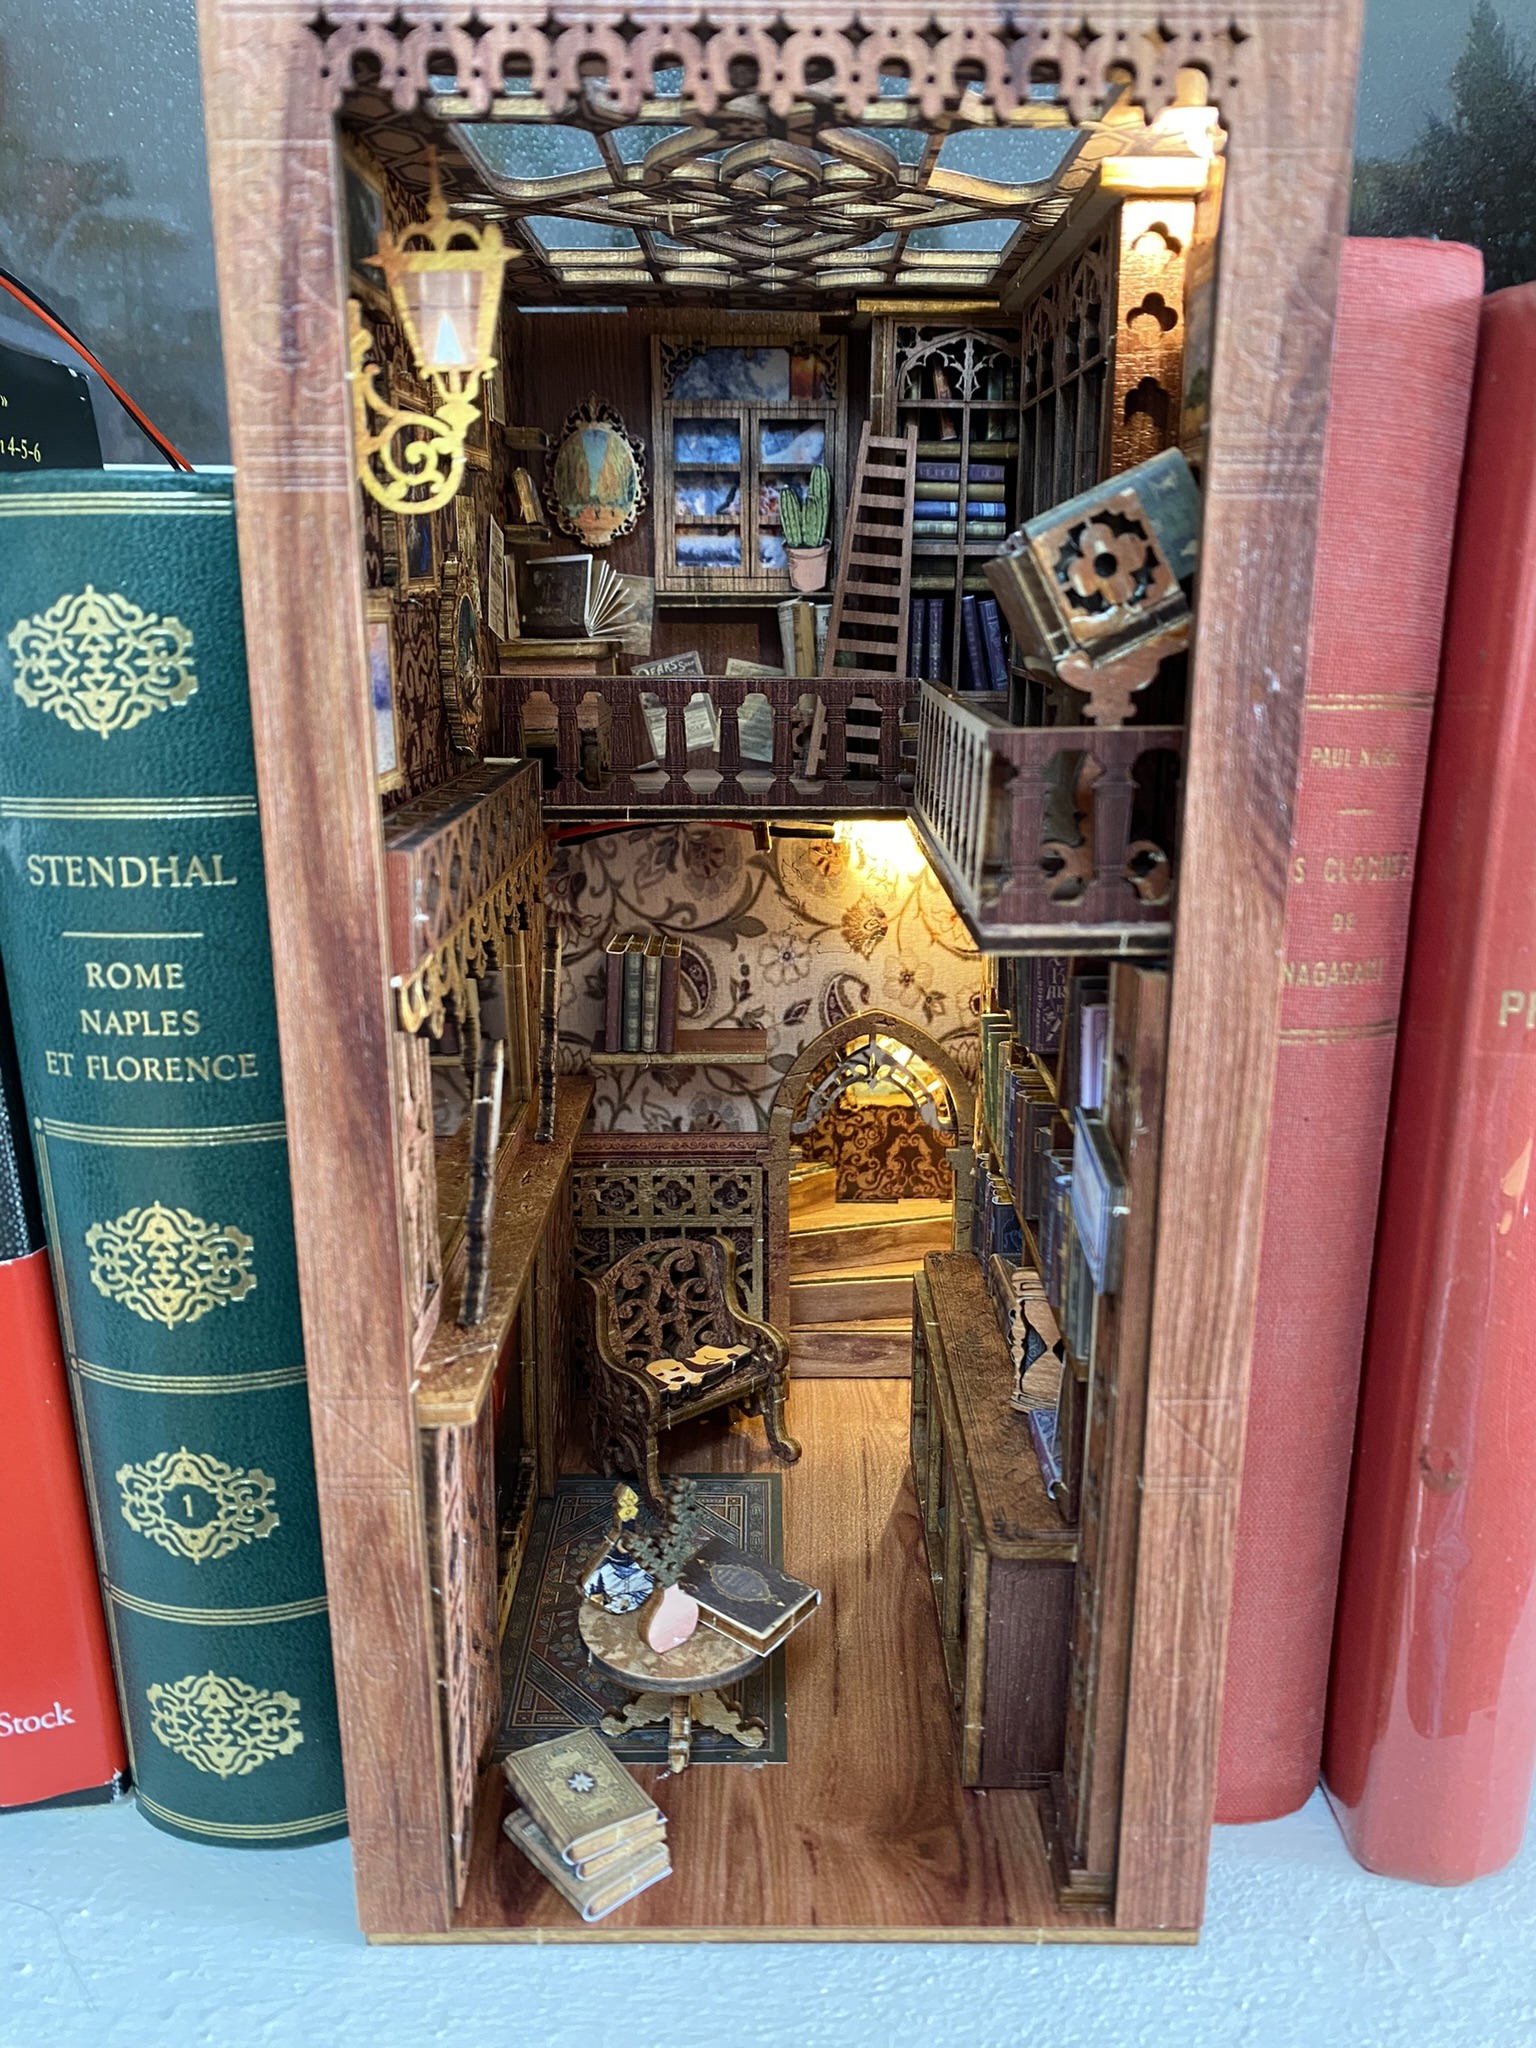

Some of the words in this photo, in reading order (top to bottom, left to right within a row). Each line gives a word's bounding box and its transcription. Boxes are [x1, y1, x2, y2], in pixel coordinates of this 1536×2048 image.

[27, 853, 238, 887] STENDHAL
[85, 962, 186, 990] ROME
[80, 1008, 201, 1037] NAPLES
[45, 1050, 74, 1078] ET
[86, 1053, 260, 1083] FLORENCE
[182, 1494, 194, 1518] 1
[0, 1701, 75, 1737] Stock
